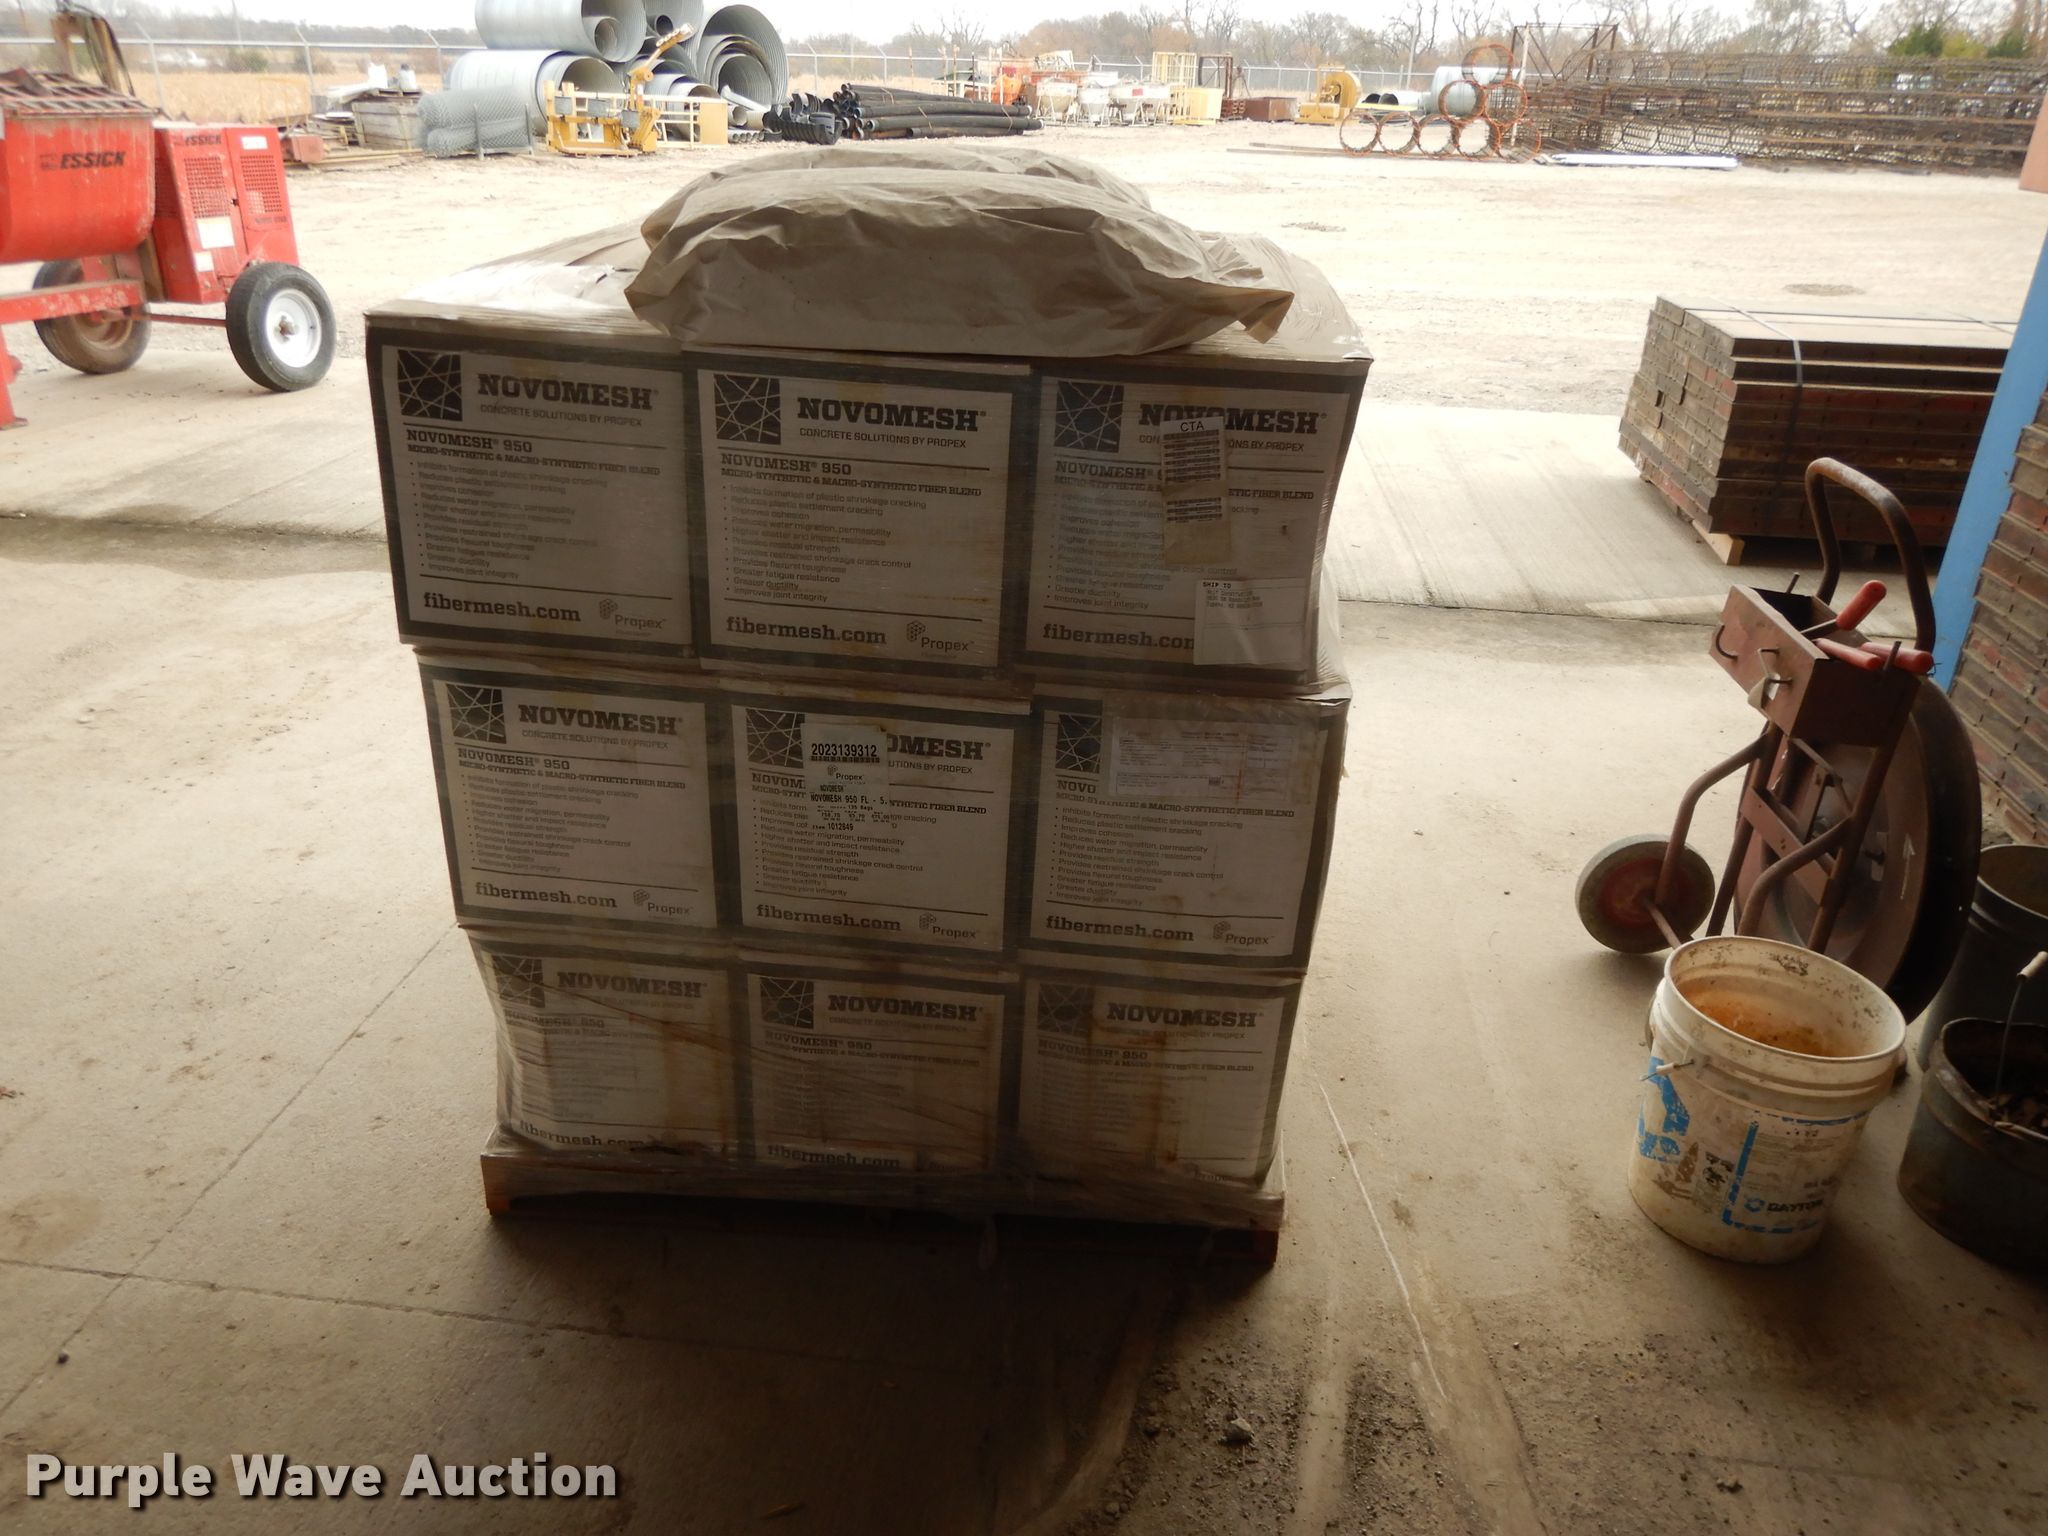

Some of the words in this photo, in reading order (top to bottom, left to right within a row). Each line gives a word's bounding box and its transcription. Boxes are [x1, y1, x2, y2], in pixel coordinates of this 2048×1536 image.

[60, 152, 125, 169] ESSICK
[477, 373, 653, 410] NOVOMESH
[481, 404, 530, 417] CONCRETE
[533, 409, 587, 422] SOLUTIONS
[590, 414, 600, 423] BY
[604, 416, 641, 427] PROPEX
[797, 397, 978, 432] NOVOMESH
[1181, 421, 1205, 432] CTA
[407, 430, 492, 449] NOVOMESH
[504, 439, 532, 452] 950
[800, 428, 852, 440] CONCRETE
[854, 431, 909, 444] SOLUTIONS
[912, 436, 924, 445] BY
[927, 437, 966, 448] PROPEX
[1252, 441, 1263, 450] BY
[1266, 441, 1304, 452] PROPEX
[721, 454, 810, 472] NOVOMESH
[822, 462, 851, 475] 950
[1056, 461, 1145, 479] NOVOMESH
[822, 476, 916, 491] MACRO-SYNTHETIC
[919, 484, 947, 494] FIBER
[424, 592, 581, 622] fibermesh.com
[615, 614, 662, 630] Propex
[726, 616, 887, 644] fibermesh.com
[921, 637, 968, 652] Propex
[518, 704, 677, 735] NOVOMESH
[811, 743, 877, 757] 2023139312
[887, 735, 983, 760] OMESH
[458, 748, 534, 766] NOVOMESH
[544, 757, 569, 769] 950
[889, 761, 922, 771] UTIONS
[924, 764, 935, 772] BY
[938, 765, 972, 774] PROPEX
[752, 773, 805, 789] NOVOM
[1056, 780, 1096, 794] NOVO
[752, 785, 805, 798] MICRO-SYNT
[811, 794, 841, 802] NOVOMESH
[845, 795, 857, 803] 950
[861, 796, 869, 804] FL
[929, 803, 955, 812] FIBER
[957, 805, 986, 814] BLEND
[1148, 803, 1234, 814] MACRO-SYNTHETIC
[475, 882, 617, 908] fibermesh.com
[648, 902, 690, 915] Propex
[757, 905, 901, 931] fibermesh.com
[933, 926, 976, 939] Propex
[1046, 915, 1194, 941] fibermesh.com
[1225, 933, 1269, 946] Propex
[557, 972, 701, 998] NOVOMESH
[828, 995, 977, 1021] NOVOMESH
[1107, 1002, 1256, 1027] NOVOMESH
[848, 1039, 872, 1050] 950
[1123, 1048, 1148, 1060] 950
[520, 1119, 644, 1147] fibermeshcom
[768, 1145, 900, 1169] fibermesh.com
